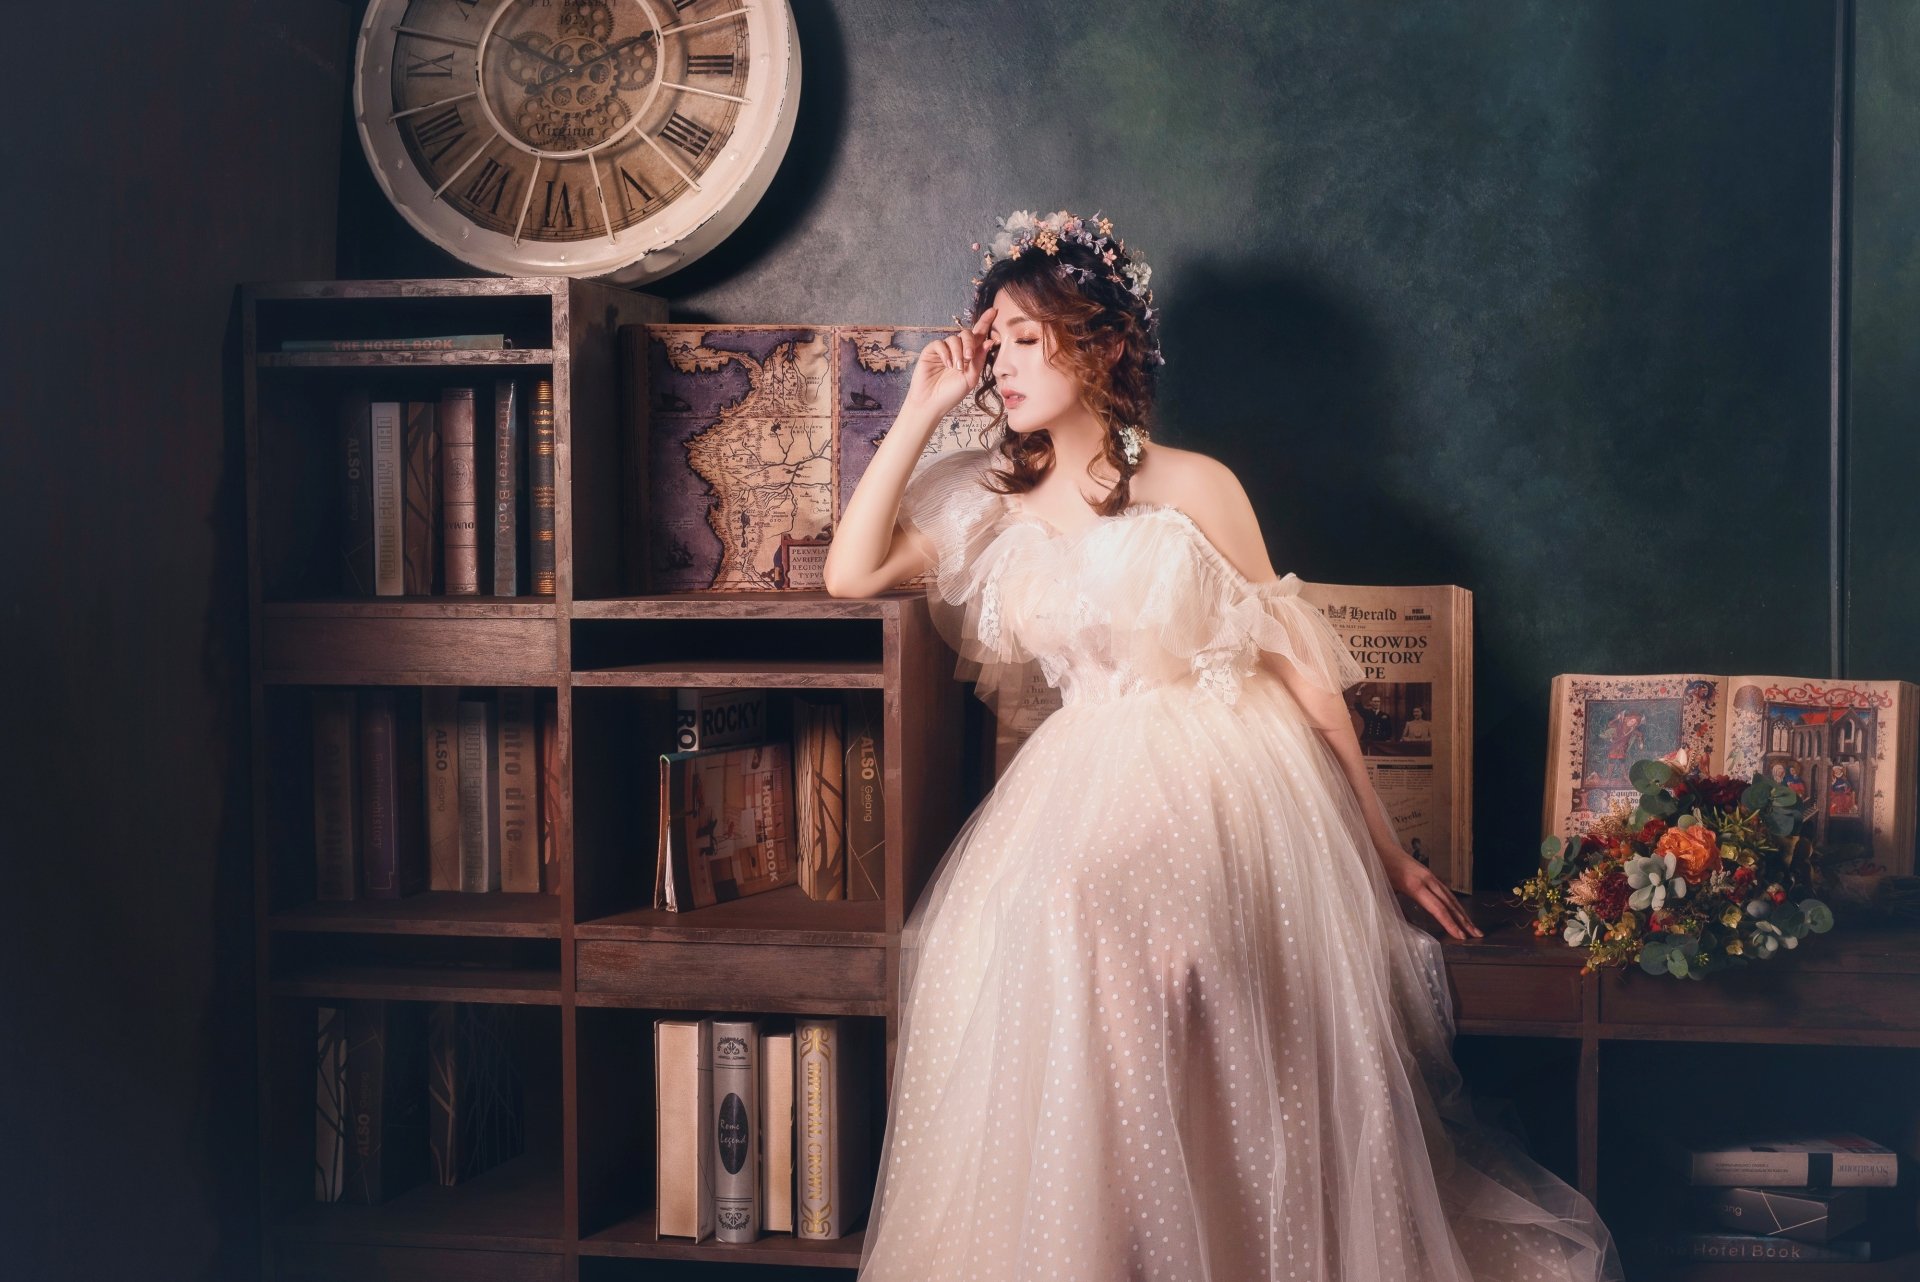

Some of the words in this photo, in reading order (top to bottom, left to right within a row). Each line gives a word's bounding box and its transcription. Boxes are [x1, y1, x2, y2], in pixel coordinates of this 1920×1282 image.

[534, 123, 594, 139] Virginia
[333, 341, 360, 351] THE
[364, 340, 409, 351] HOTEL
[413, 338, 454, 350] BOOK
[347, 437, 361, 480] ALSO
[499, 435, 510, 484] Hotel
[499, 490, 510, 534] Book
[1349, 606, 1397, 624] Herald
[1350, 634, 1428, 649] CROWDS
[1350, 650, 1425, 664] VICTORY
[677, 709, 697, 750] RO
[702, 700, 762, 736] ROCKY
[434, 728, 448, 772] ALSO
[860, 736, 875, 780] ALSO
[505, 787, 525, 811] di
[763, 783, 774, 836] HOTEL
[863, 785, 873, 822] Gelang
[506, 818, 526, 842] te
[766, 839, 779, 882] BOOK
[357, 1113, 370, 1157] ALSO
[720, 1119, 740, 1130] Rome
[720, 1134, 747, 1148] Legend
[807, 1142, 823, 1201] CROWN
[1694, 1243, 1745, 1257] Hotel
[1752, 1244, 1801, 1258] Book
